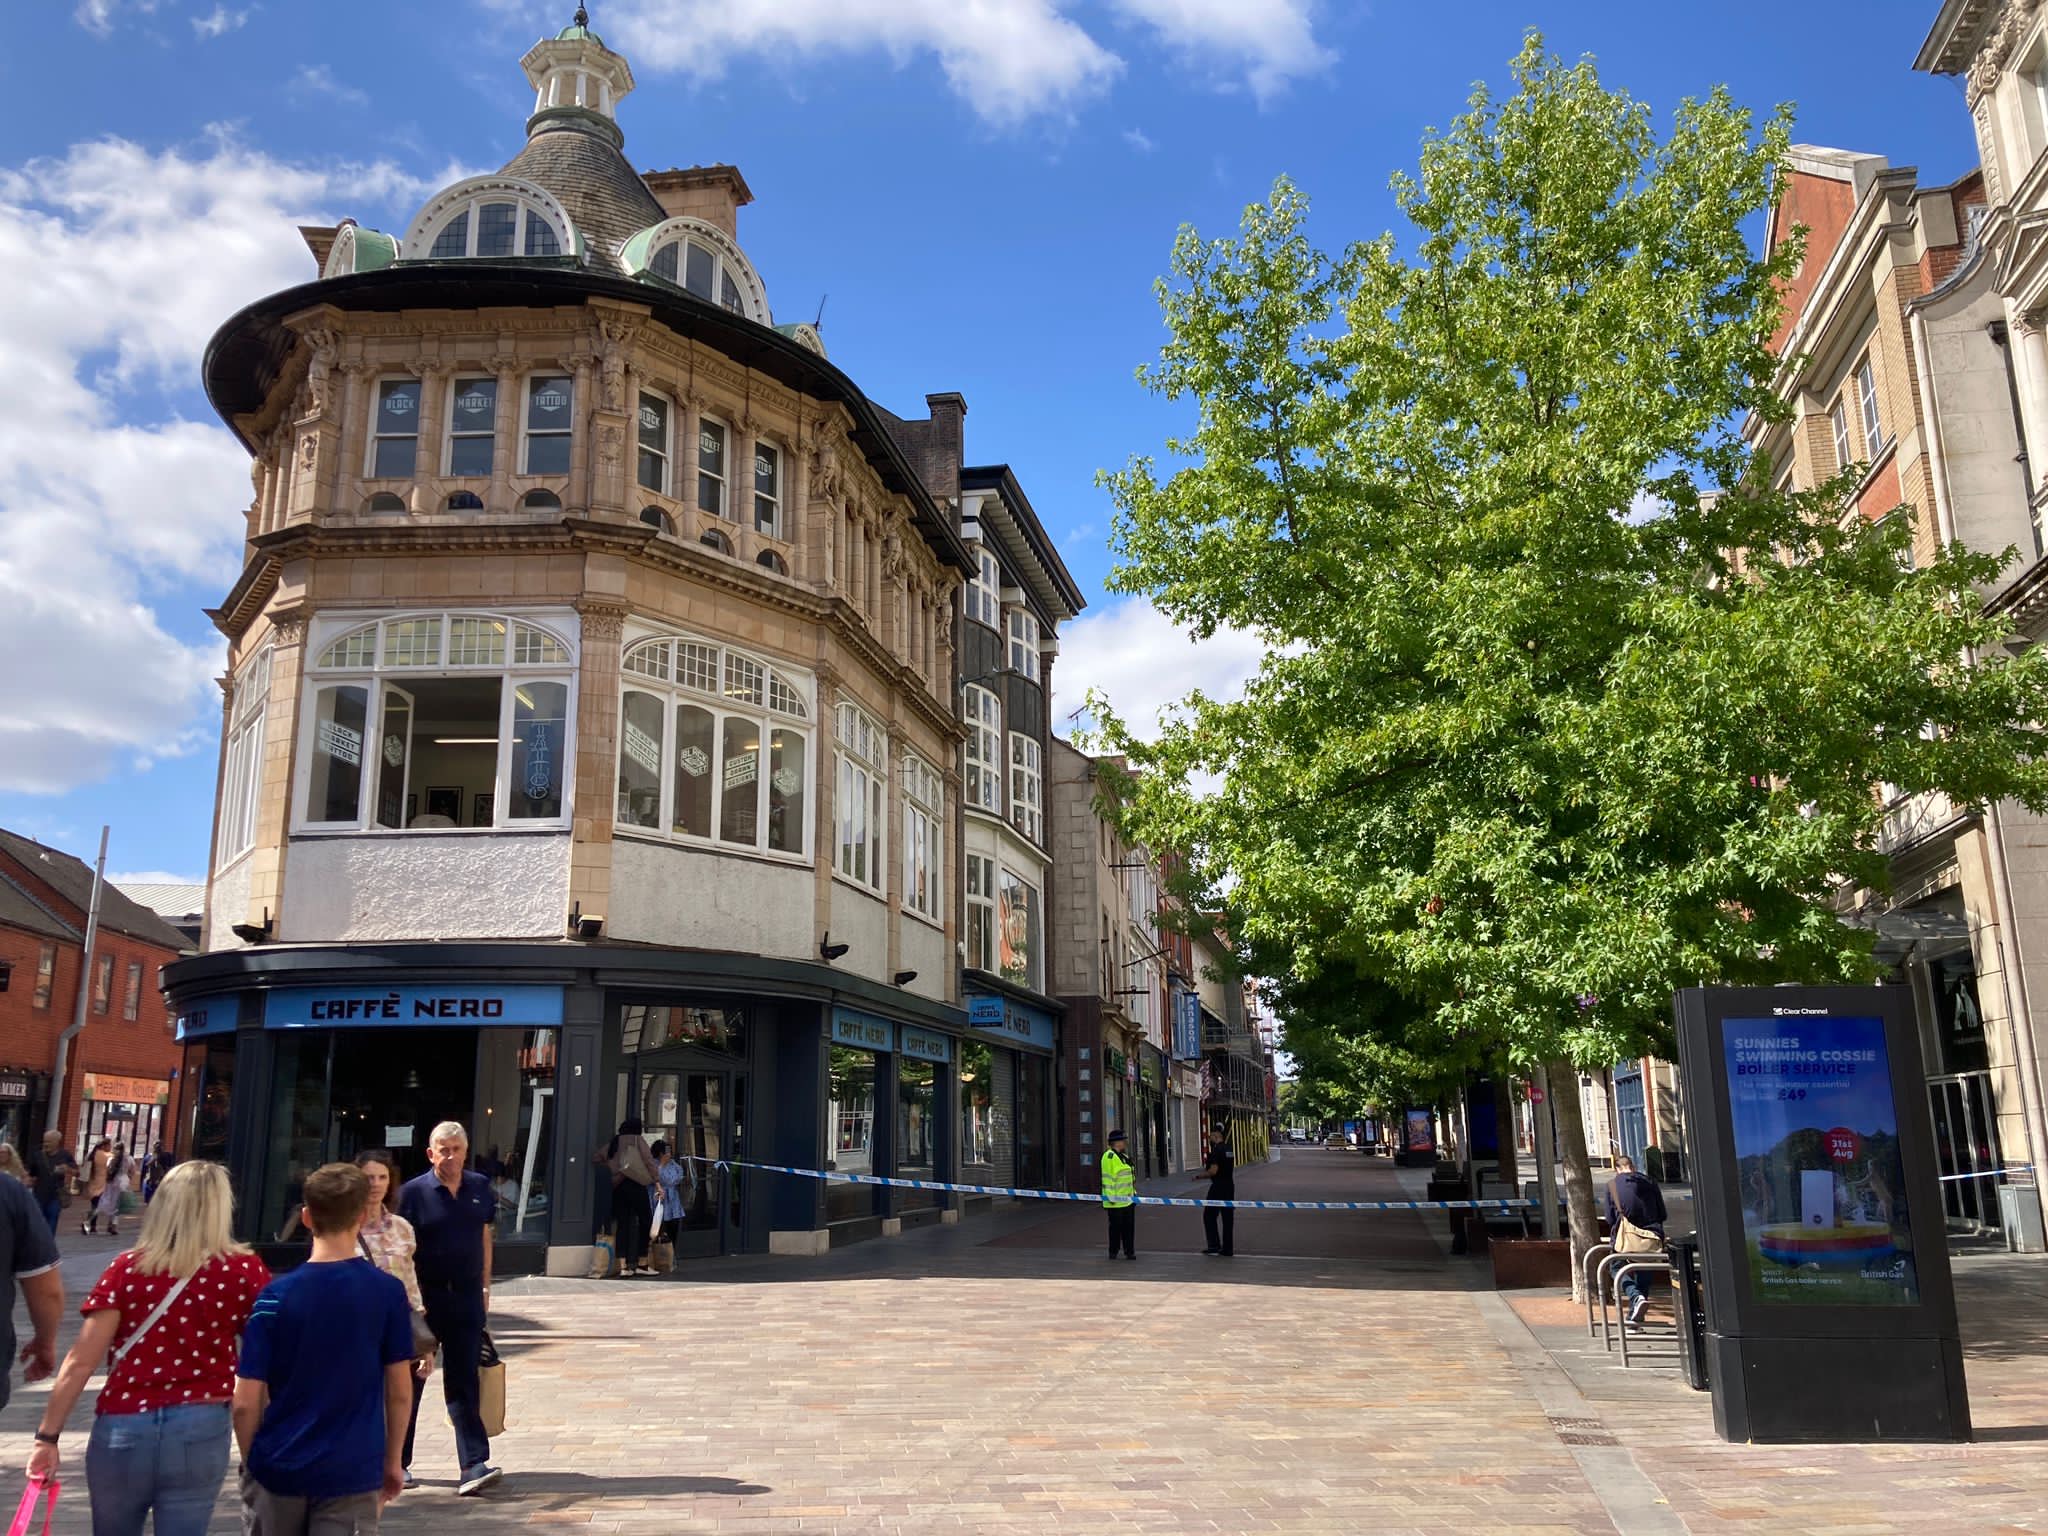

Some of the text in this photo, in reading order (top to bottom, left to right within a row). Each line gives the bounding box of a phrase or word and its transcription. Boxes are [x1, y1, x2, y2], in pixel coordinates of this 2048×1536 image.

[385, 399, 415, 410] BLACK
[458, 397, 493, 409] MARKET
[536, 395, 567, 406] TATTOO
[639, 409, 660, 427] BLACK
[729, 754, 753, 767] CUSTOM
[311, 992, 503, 1020] CAFFÈ NERO
[1801, 1007, 1828, 1015] Channel
[973, 1010, 1000, 1018] NERO
[1013, 1016, 1031, 1036] NERO
[866, 1024, 886, 1046] NERO
[1734, 1038, 1800, 1049] SUNNIES
[1735, 1050, 1876, 1062] SWIMMING COSSIE
[1737, 1063, 1857, 1075] BOILER SERVICE
[1778, 1089, 1807, 1101] £49
[1833, 1149, 1854, 1160] Aug
[1860, 1269, 1905, 1279] British Gas
